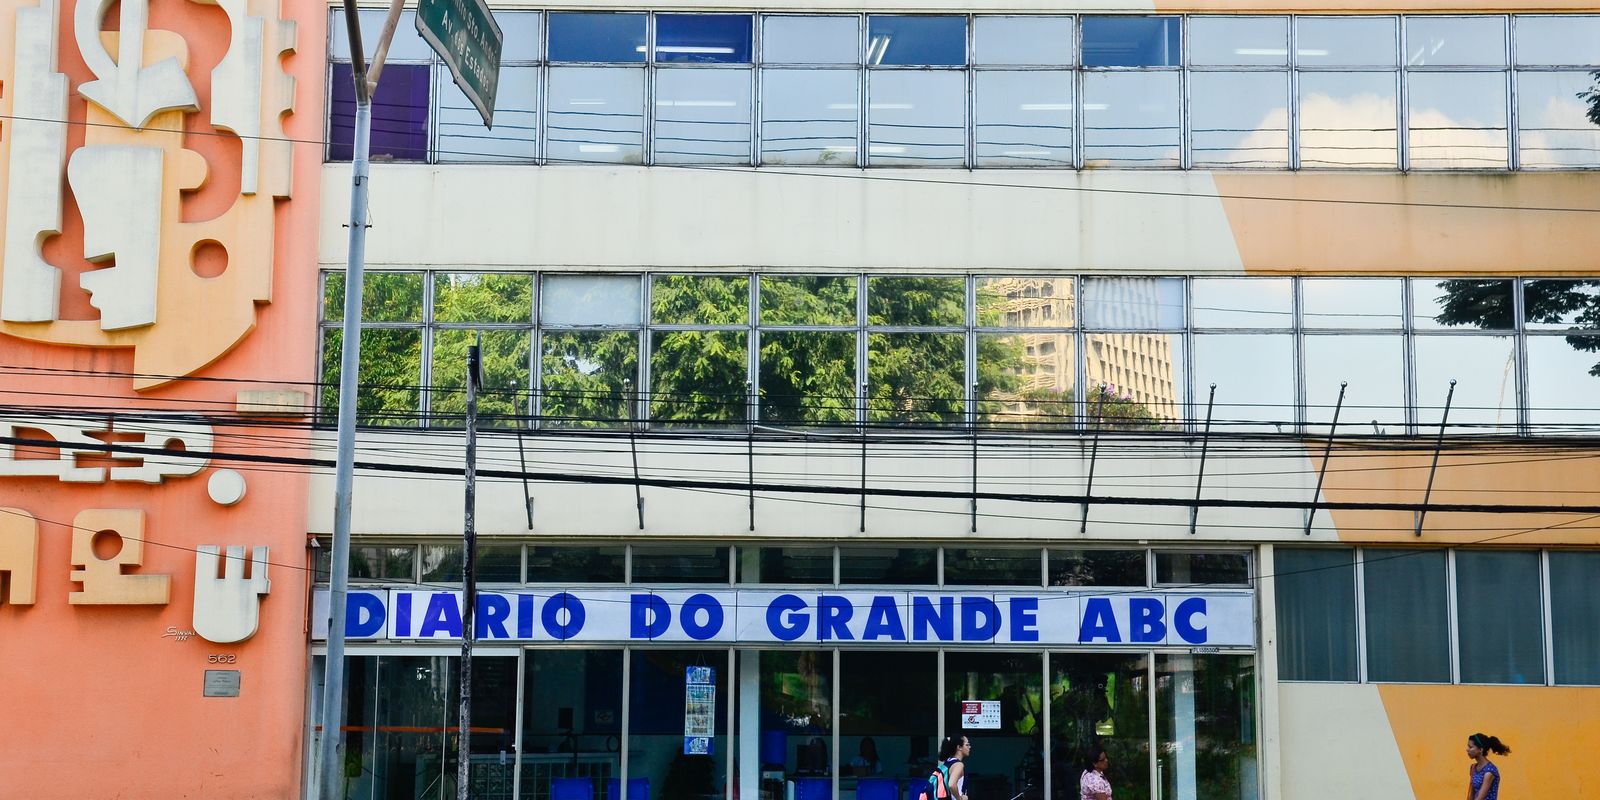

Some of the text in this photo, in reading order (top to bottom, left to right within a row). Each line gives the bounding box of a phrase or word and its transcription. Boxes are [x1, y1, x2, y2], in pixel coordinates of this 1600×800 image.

[467, 11, 480, 42] Sto.
[441, 10, 453, 39] Av.
[465, 46, 489, 92] Estados
[630, 593, 725, 640] DO
[765, 593, 1040, 643] GRANDE
[1080, 597, 1208, 644] ABC
[207, 654, 236, 664] 562
